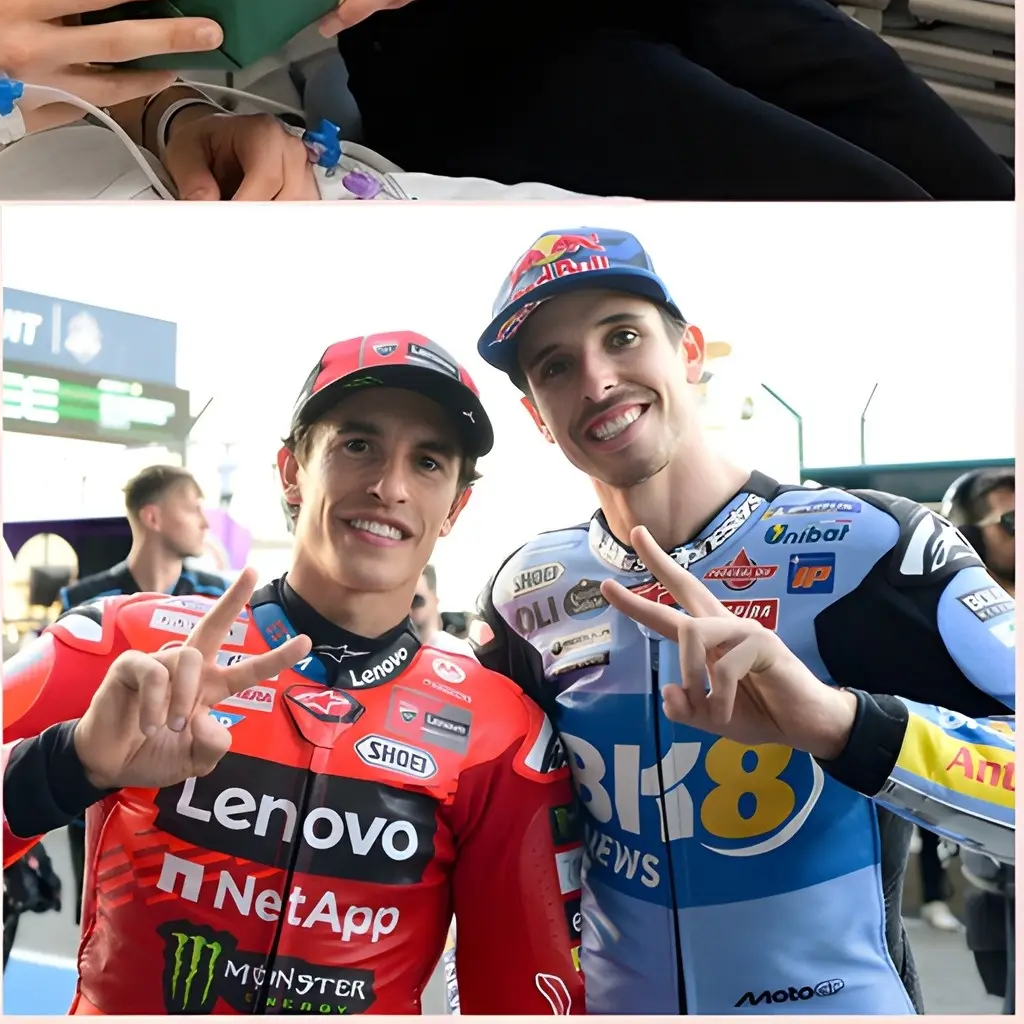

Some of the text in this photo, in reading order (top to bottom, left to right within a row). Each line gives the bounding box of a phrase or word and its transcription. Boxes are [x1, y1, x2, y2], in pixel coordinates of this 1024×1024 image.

[764, 524, 850, 545] Unibat
[792, 566, 832, 588] IP
[349, 647, 408, 687] Lenovo
[368, 740, 427, 774] SHOEI
[176, 775, 419, 861] Lenovo
[214, 875, 400, 943] NetApp
[224, 959, 366, 1001] MONSTER
